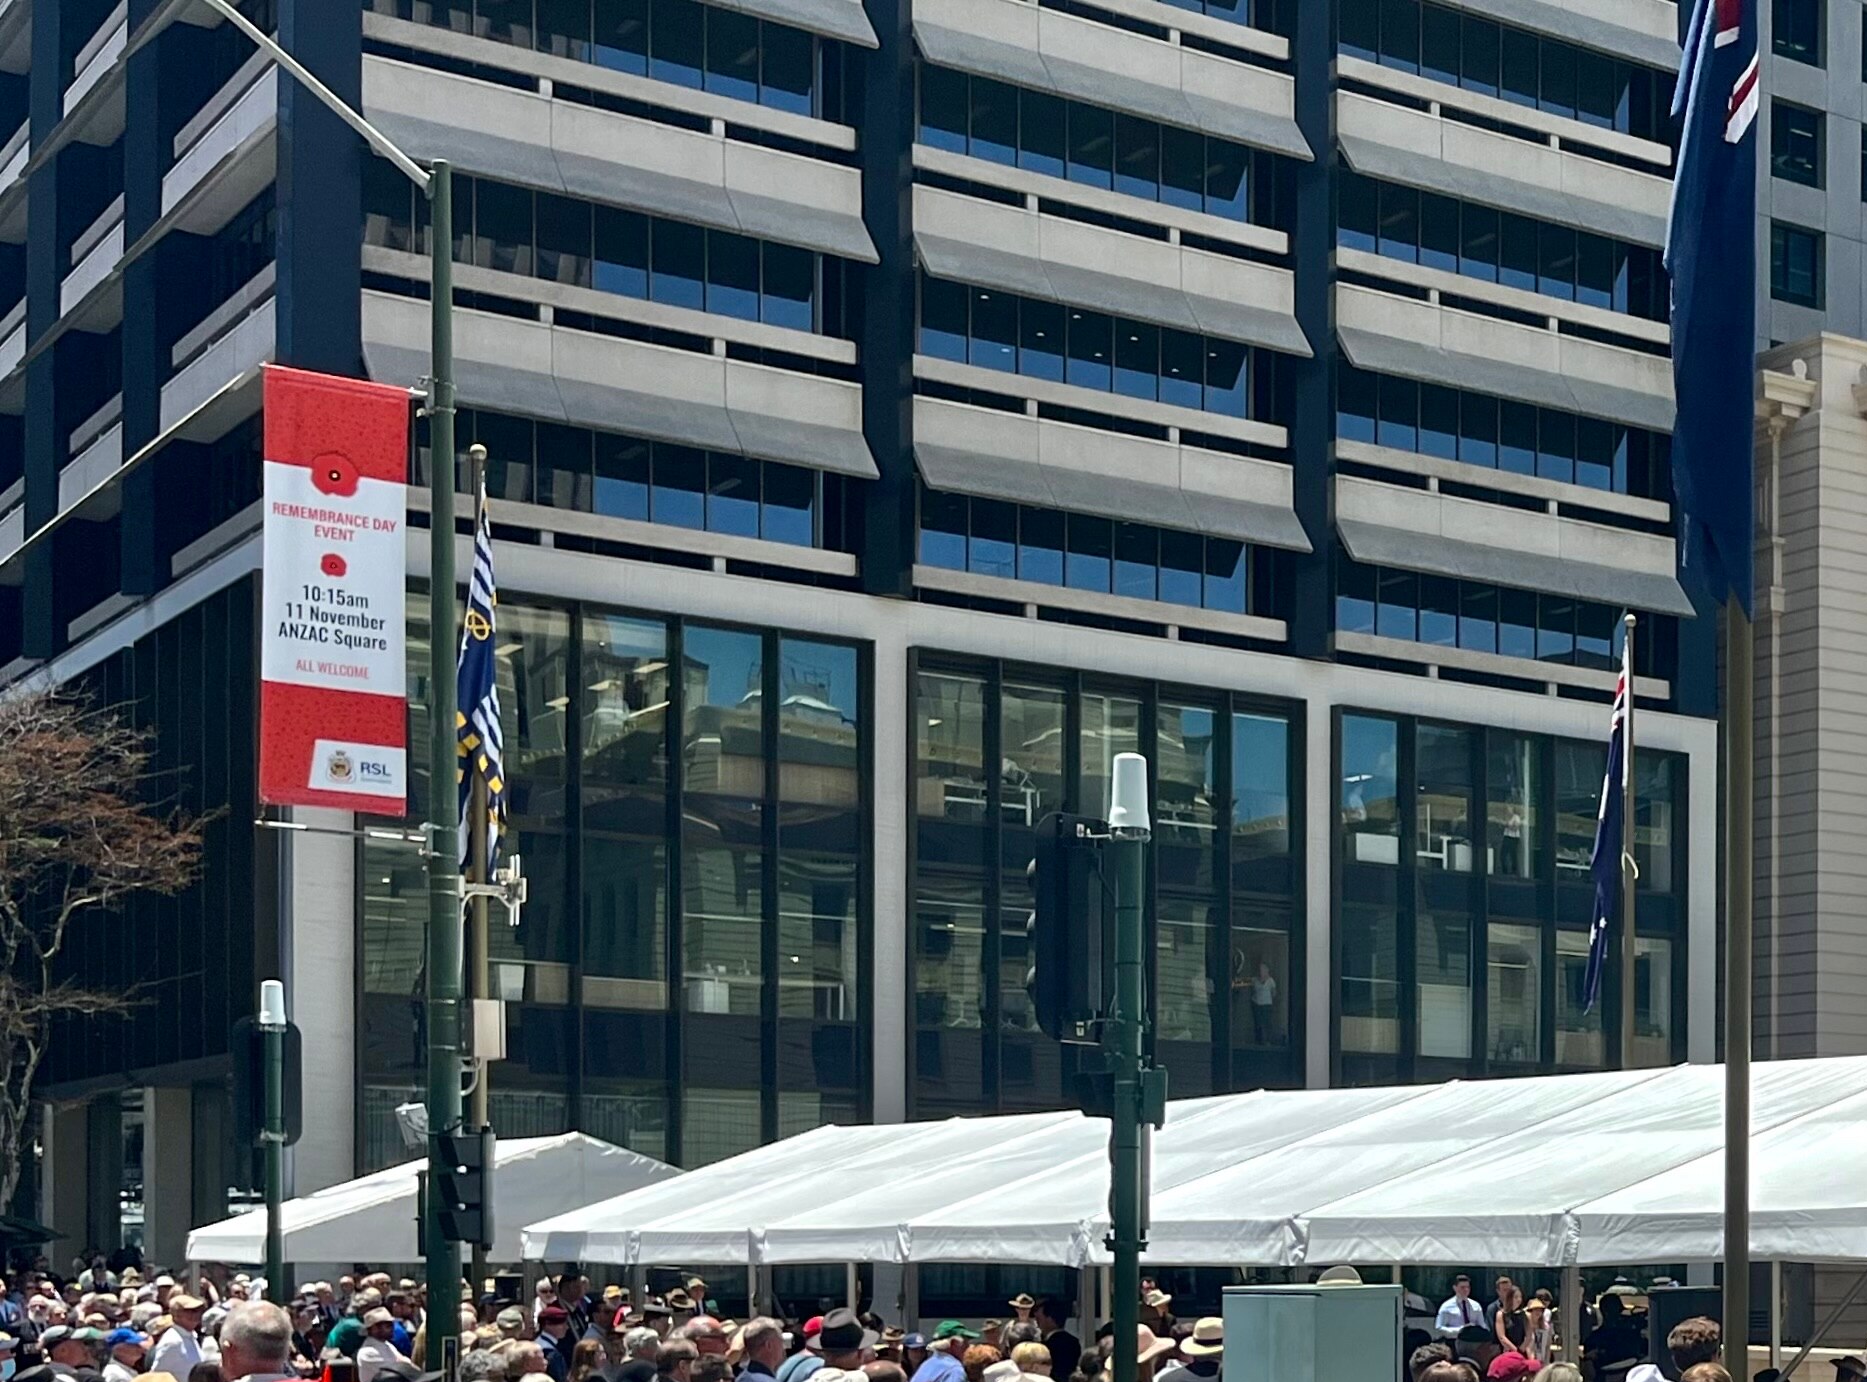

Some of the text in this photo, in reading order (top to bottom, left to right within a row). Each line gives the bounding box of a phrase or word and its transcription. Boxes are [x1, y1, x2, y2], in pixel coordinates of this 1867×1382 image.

[272, 502, 397, 533] REMEMBRANCE DAY
[314, 525, 355, 542] EVENT
[303, 584, 369, 609] 10:15am
[286, 602, 385, 631] 11 November
[278, 621, 387, 651] ANZAC Square
[296, 659, 370, 680] ALL WELCOME
[360, 761, 392, 777] RSL
